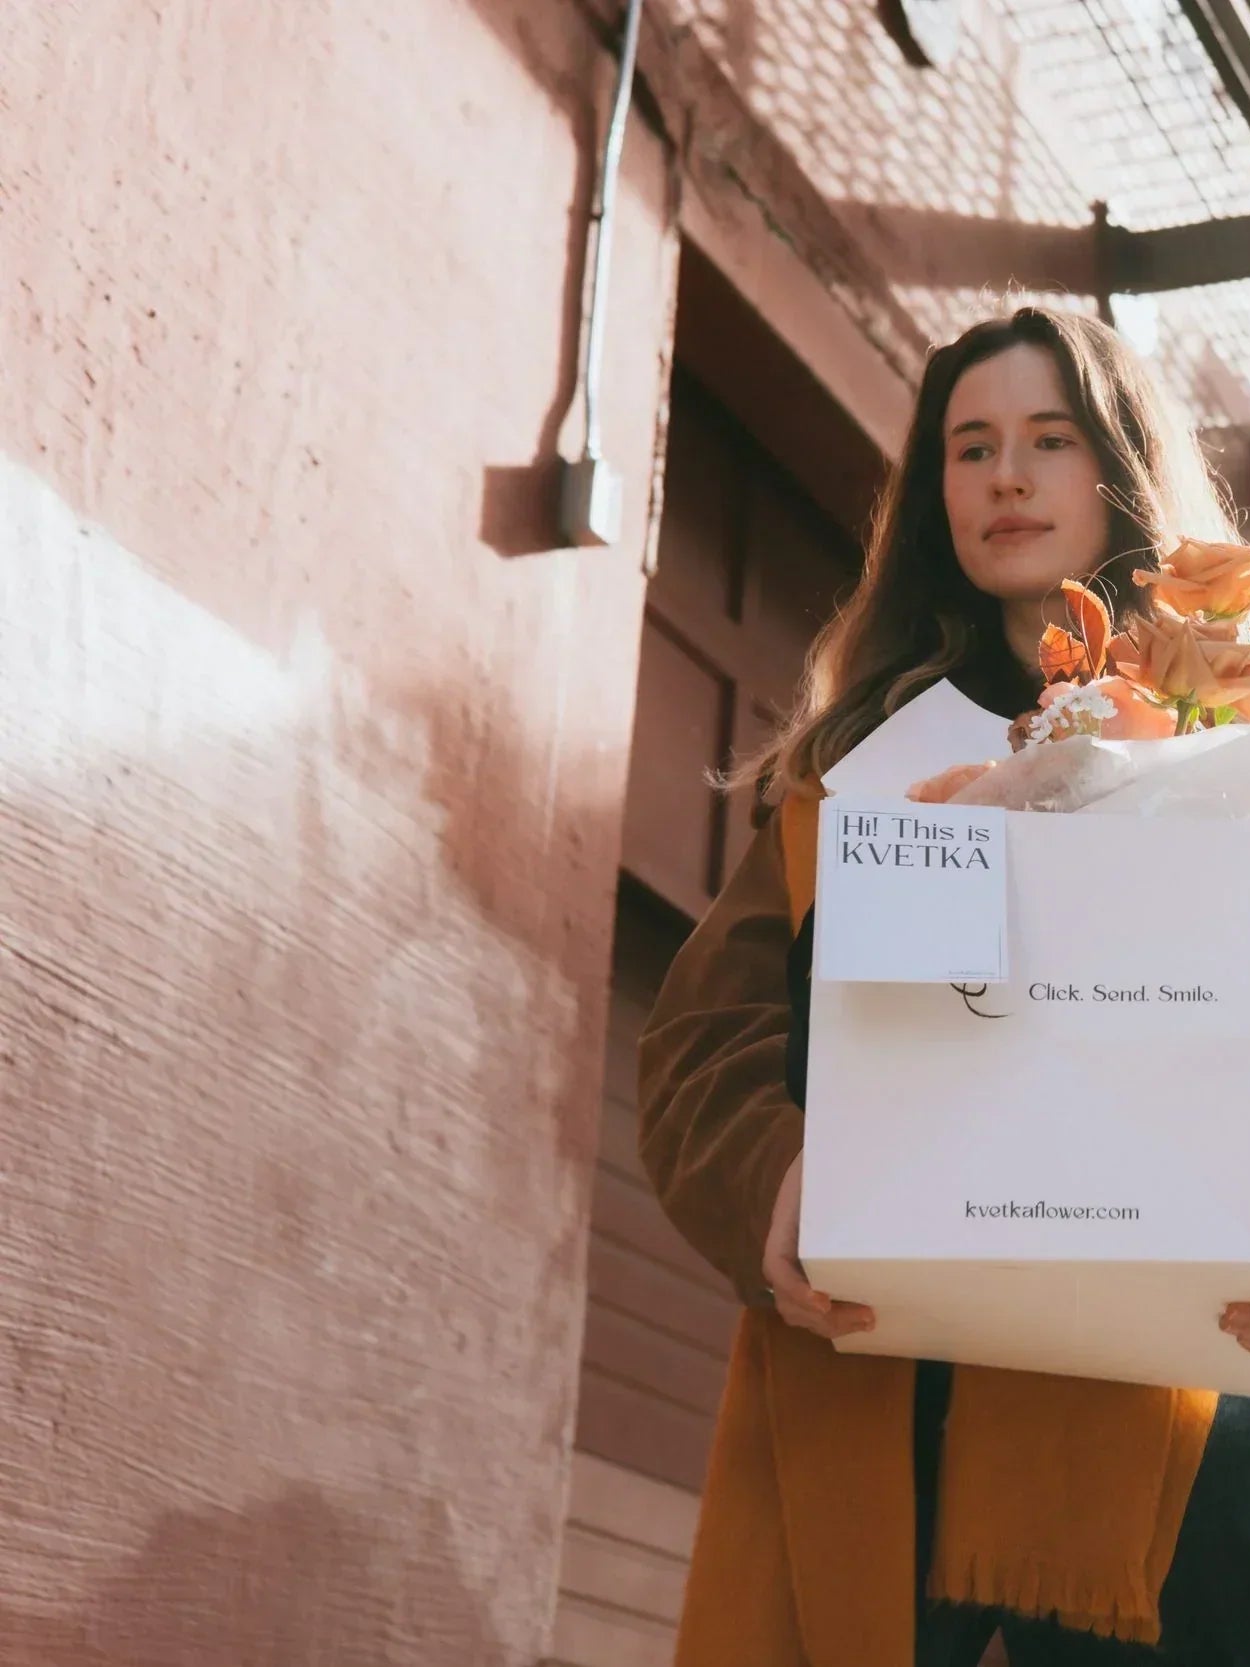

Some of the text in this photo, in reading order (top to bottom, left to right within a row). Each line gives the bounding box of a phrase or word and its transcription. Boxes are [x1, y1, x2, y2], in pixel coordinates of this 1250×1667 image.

[843, 815, 990, 842] Hi! This is
[842, 841, 990, 870] KVETKA
[1028, 982, 1219, 1002] Click. Send. Smile.
[965, 1200, 1140, 1220] kvetkaflower.com
